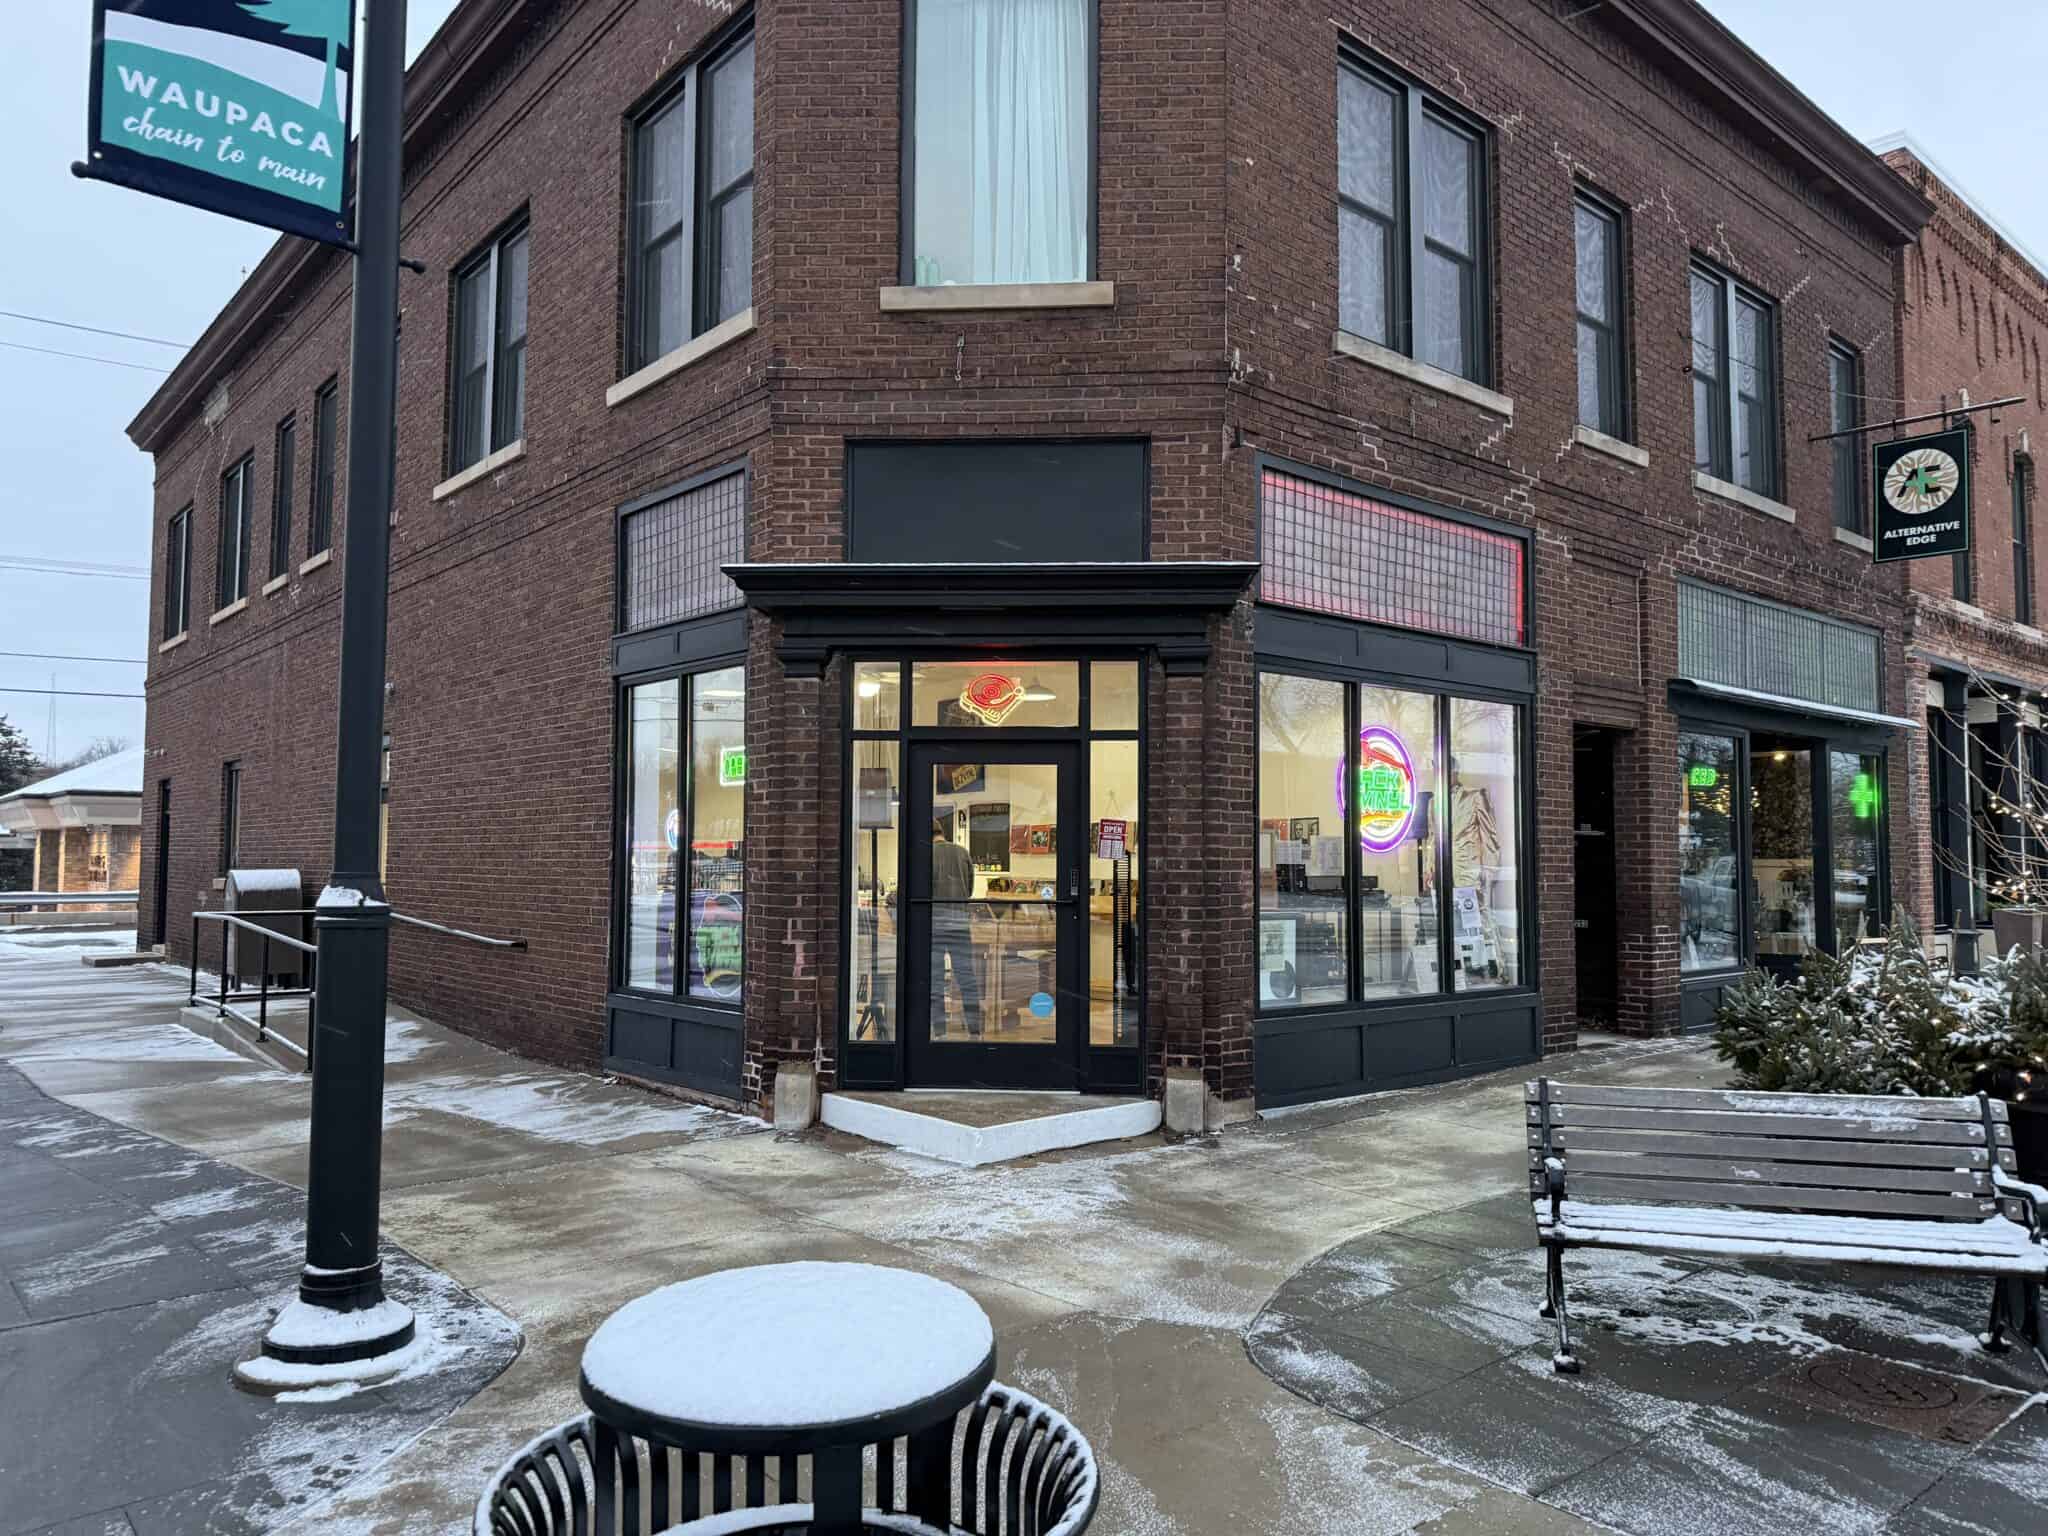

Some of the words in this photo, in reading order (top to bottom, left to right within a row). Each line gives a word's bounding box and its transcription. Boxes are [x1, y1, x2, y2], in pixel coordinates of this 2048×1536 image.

[117, 65, 334, 158] WAUPACA
[122, 107, 204, 153] chain
[216, 136, 246, 163] to
[258, 155, 327, 191] main
[1884, 520, 1961, 540] ALTERNATIVE
[1906, 533, 1937, 546] EDGE
[724, 754, 745, 778] OPE
[1103, 825, 1124, 834] OPEN
